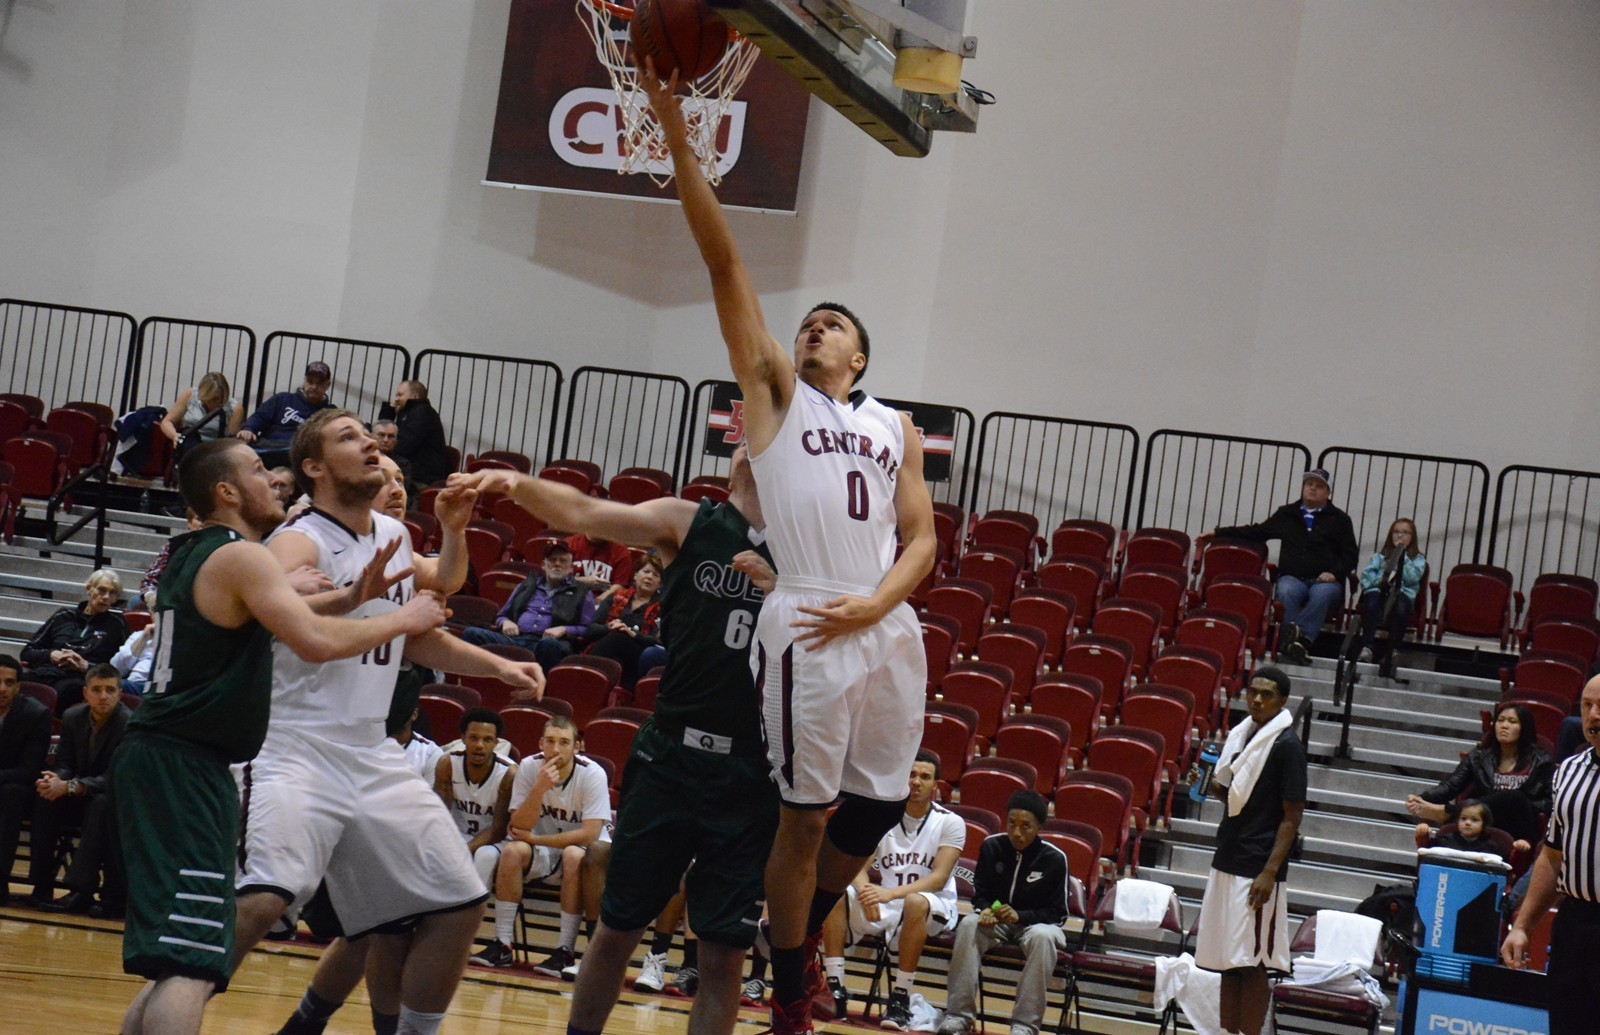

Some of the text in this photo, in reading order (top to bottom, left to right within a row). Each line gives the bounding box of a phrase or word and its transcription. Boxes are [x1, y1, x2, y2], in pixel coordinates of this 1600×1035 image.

[801, 428, 898, 482] CENTRAL
[847, 470, 869, 521] 0
[724, 609, 753, 650] 6
[700, 735, 714, 750] Q
[1431, 872, 1449, 948] POWERADE
